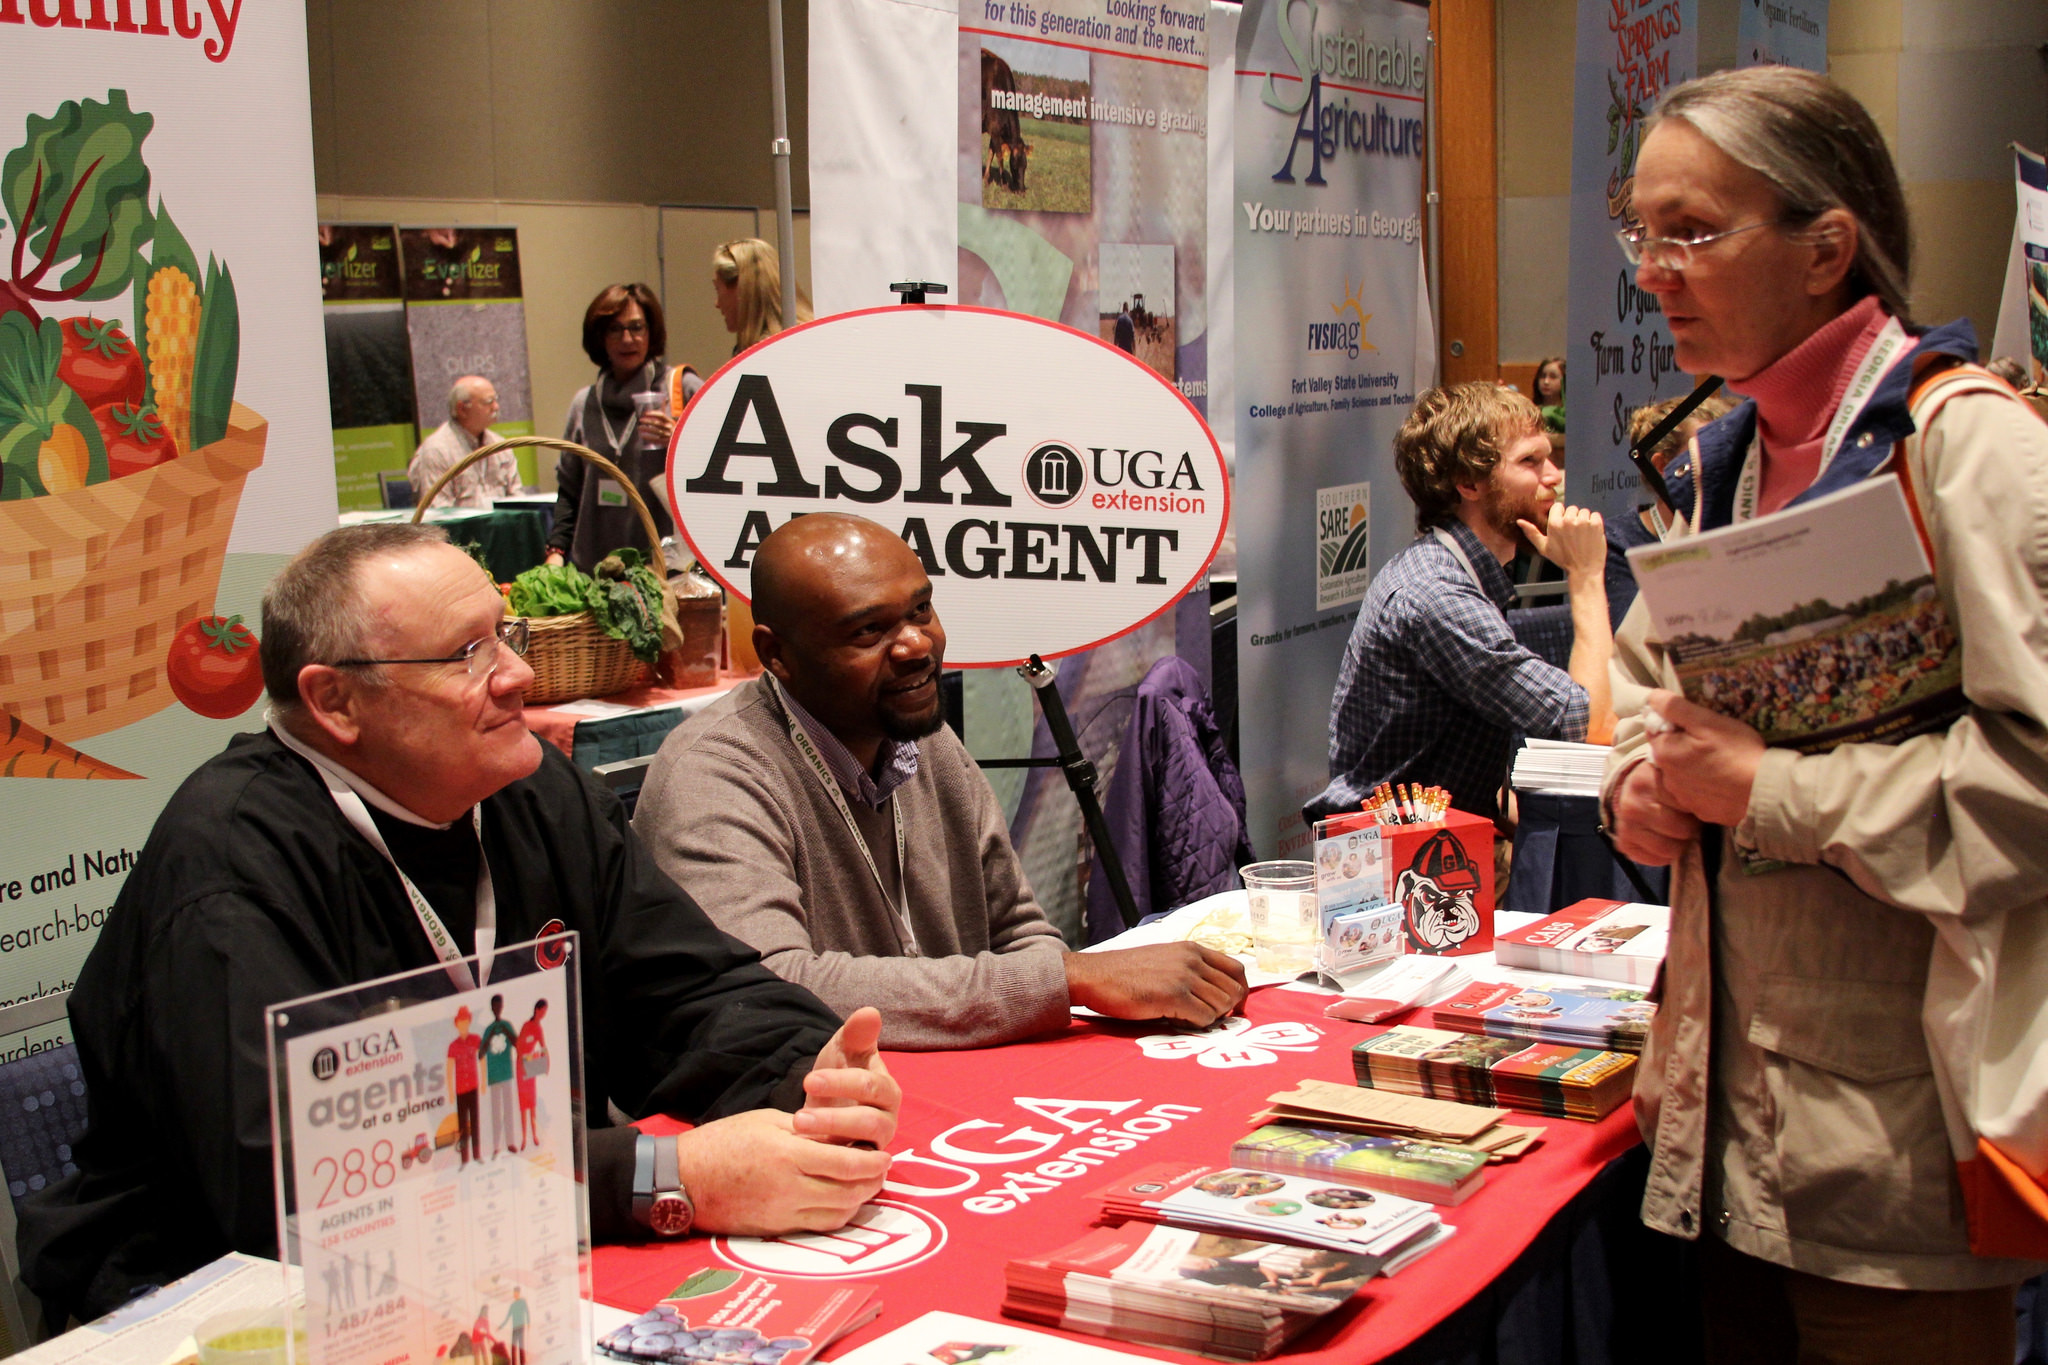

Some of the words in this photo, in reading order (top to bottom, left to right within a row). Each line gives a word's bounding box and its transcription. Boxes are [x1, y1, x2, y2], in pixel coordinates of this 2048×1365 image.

[985, 0, 1006, 21] for
[1010, 2, 1037, 27] this
[1040, 12, 1111, 41] generation
[1114, 21, 1138, 46] and
[1143, 26, 1163, 50] the
[1106, 0, 1156, 27] Looking
[1160, 4, 1205, 32] forward
[1259, 0, 1424, 114] Sustainable
[1616, 0, 1682, 75] SPRINGS
[991, 89, 1088, 119] management
[1090, 97, 1156, 127] intensive
[1160, 107, 1206, 137] grazing
[1623, 49, 1670, 138] FARM
[1271, 74, 1424, 186] Agriculture
[1243, 202, 1292, 234] Your
[1294, 207, 1351, 239] partners
[1355, 209, 1368, 236] in
[1371, 210, 1422, 244] Georgia
[423, 256, 501, 281] Everlizer
[1308, 321, 1361, 360] FVSUag
[1590, 331, 1625, 386] Farm
[1631, 334, 1645, 374] &
[1292, 378, 1307, 395] Fort
[1308, 376, 1333, 395] Valley
[1334, 374, 1357, 391] State
[1358, 371, 1399, 390] University
[1852, 338, 1895, 399] GEORGIA
[1249, 404, 1287, 420] College
[1379, 393, 1392, 406] and
[685, 373, 1012, 508] Ask
[1087, 446, 1206, 492] UGA
[1091, 487, 1205, 515] extension
[1319, 488, 1368, 508] SOUTHERN
[1320, 506, 1349, 541] SARE
[900, 516, 1179, 586] AGENT
[1250, 631, 1283, 647] Grants
[795, 732, 834, 786] ORGANICS
[1359, 830, 1379, 843] UGA
[30, 854, 77, 896] and
[411, 888, 447, 948] GEORGIA
[1525, 921, 1575, 944] CAES
[343, 1028, 400, 1063] UGA
[345, 1050, 404, 1077] extension
[307, 1062, 446, 1131] agents
[362, 1115, 377, 1130] at
[382, 1111, 393, 1123] a
[397, 1095, 445, 1124] glance
[882, 1096, 1143, 1197] UGA
[962, 1102, 1203, 1215] extension
[313, 1138, 396, 1210] 288
[320, 1202, 375, 1232] AGENTS
[378, 1196, 394, 1213] IN
[343, 1214, 397, 1241] COUNTIES
